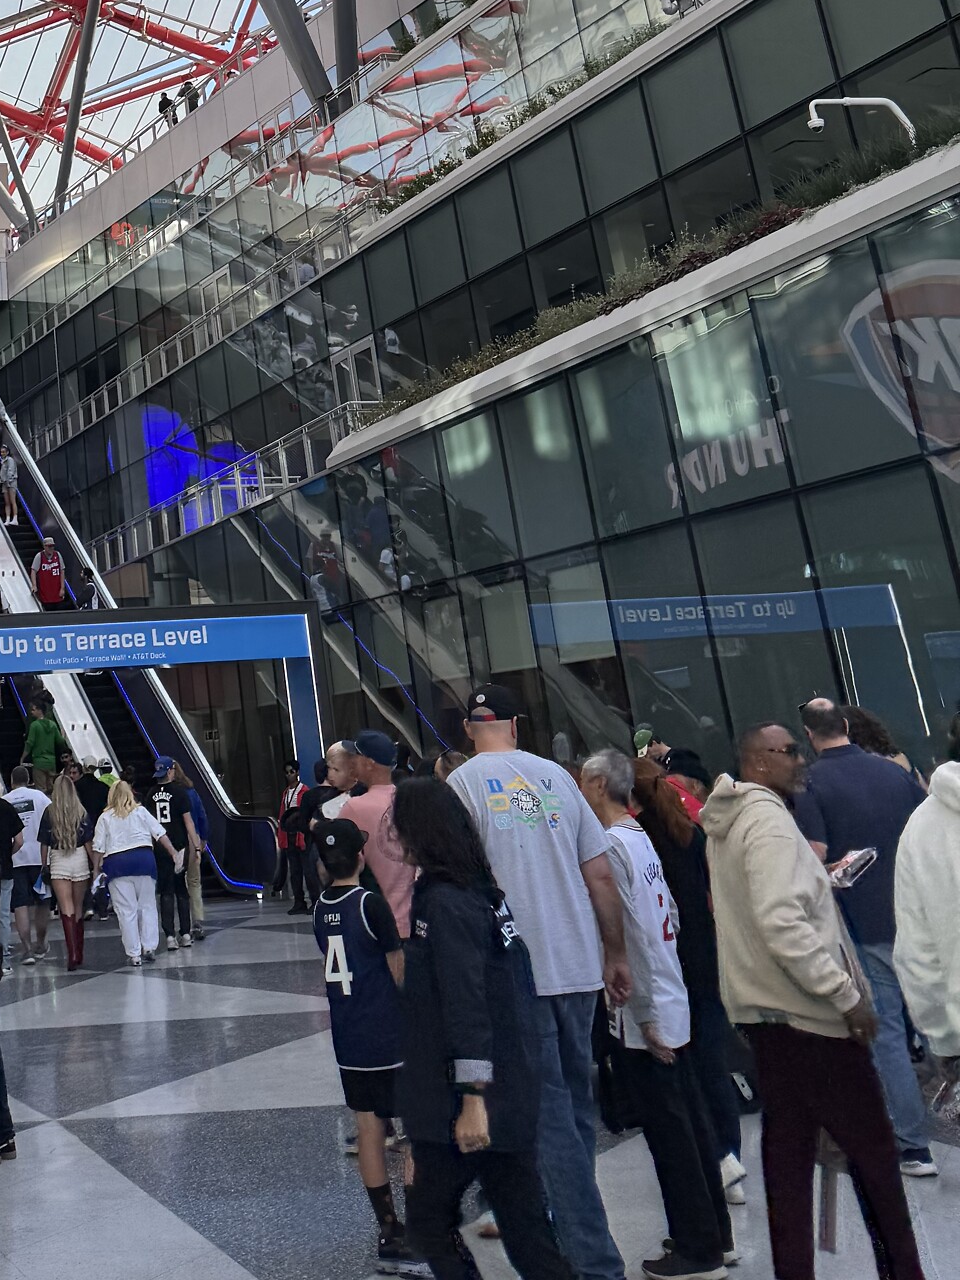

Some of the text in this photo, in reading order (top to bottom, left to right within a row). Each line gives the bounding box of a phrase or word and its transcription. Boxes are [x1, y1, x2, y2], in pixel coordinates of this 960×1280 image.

[0, 625, 209, 657] Up to Terrace Level
[132, 652, 149, 660] AT&T
[150, 651, 167, 659] Deck
[155, 802, 171, 824] 13
[325, 934, 353, 996] 4
